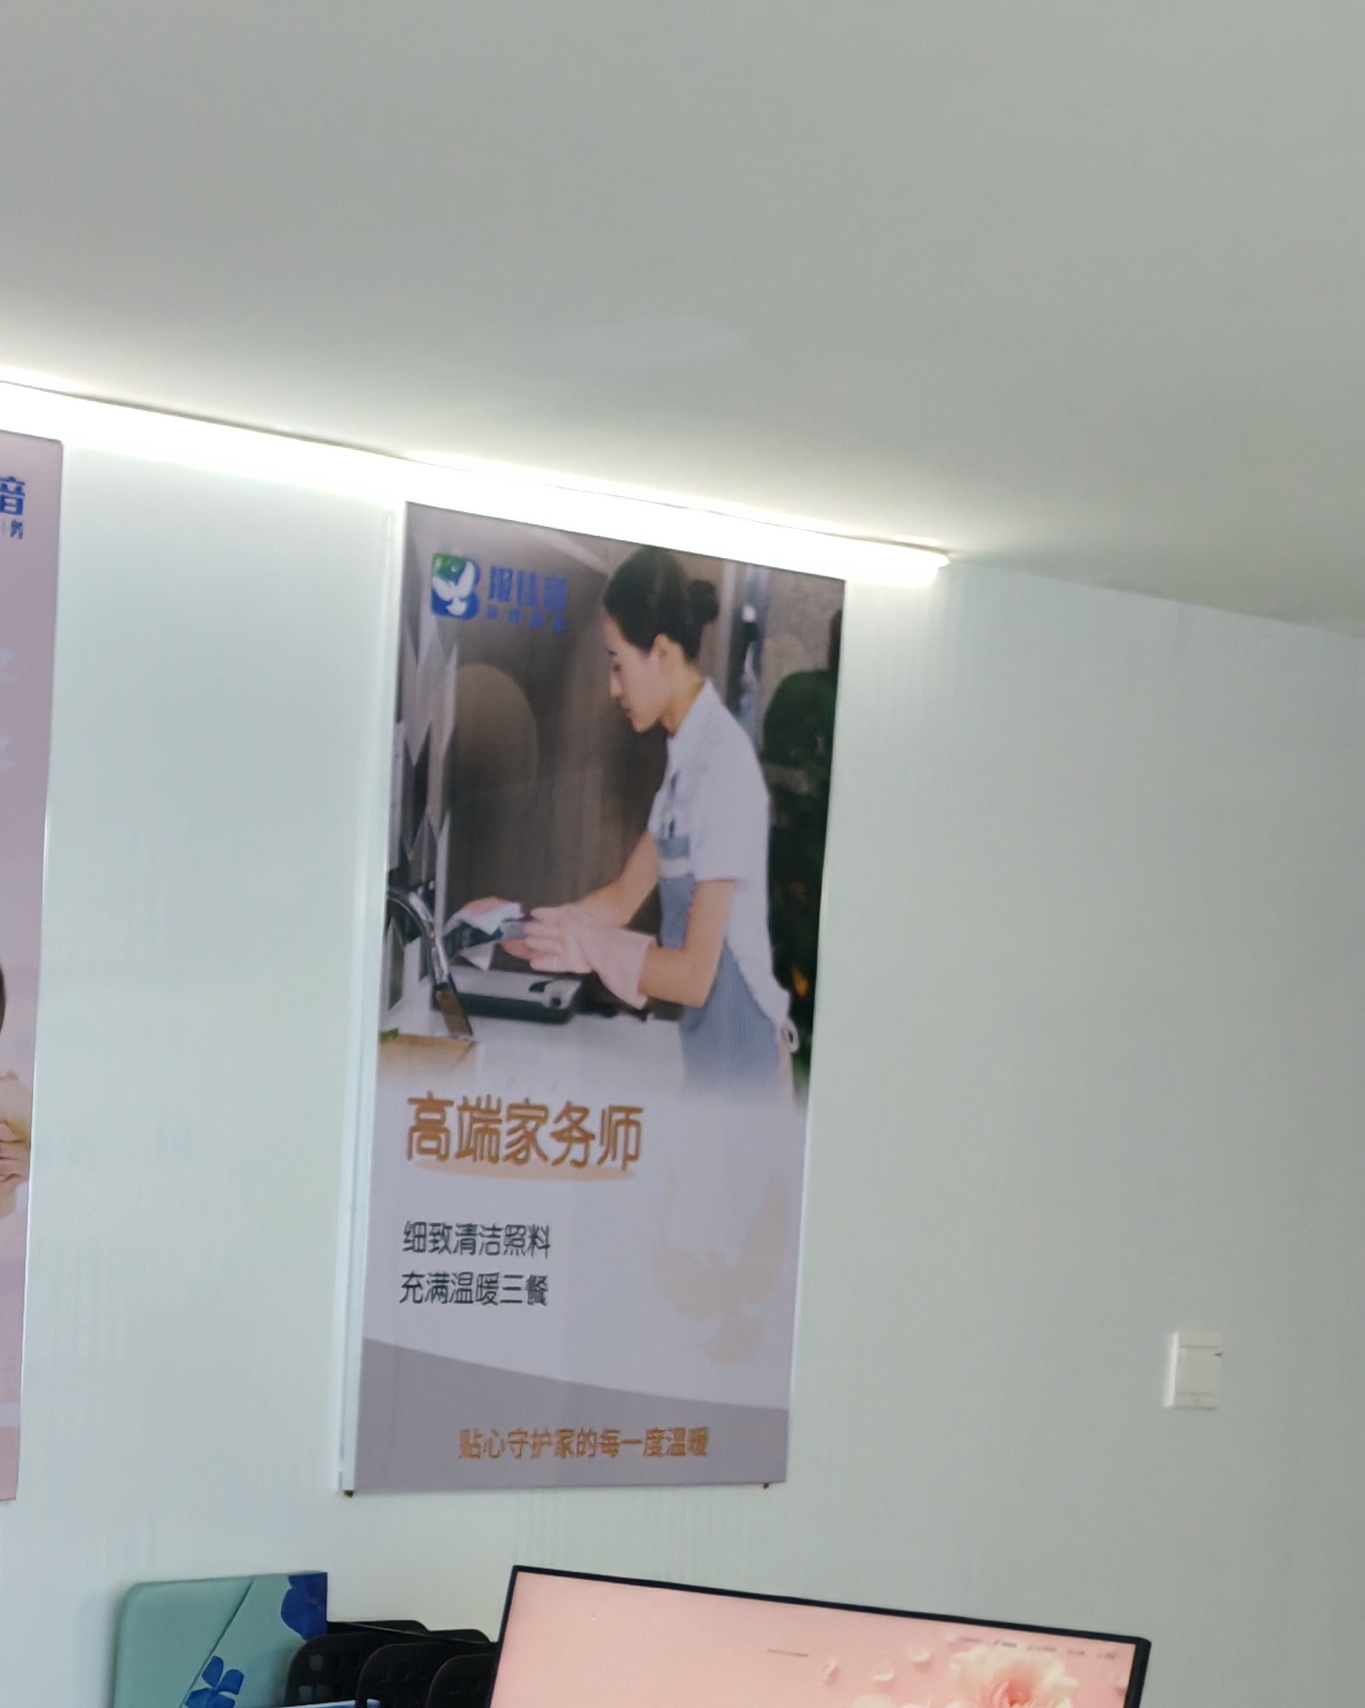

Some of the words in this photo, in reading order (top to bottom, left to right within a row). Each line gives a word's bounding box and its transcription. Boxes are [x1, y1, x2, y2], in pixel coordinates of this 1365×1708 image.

[407, 1091, 645, 1171] 高端家务师
[402, 1220, 551, 1259] 细致清洁照料
[399, 1271, 549, 1307] 充满温暖三餐
[457, 1427, 710, 1461] 贴心守护家的每一度温暖
